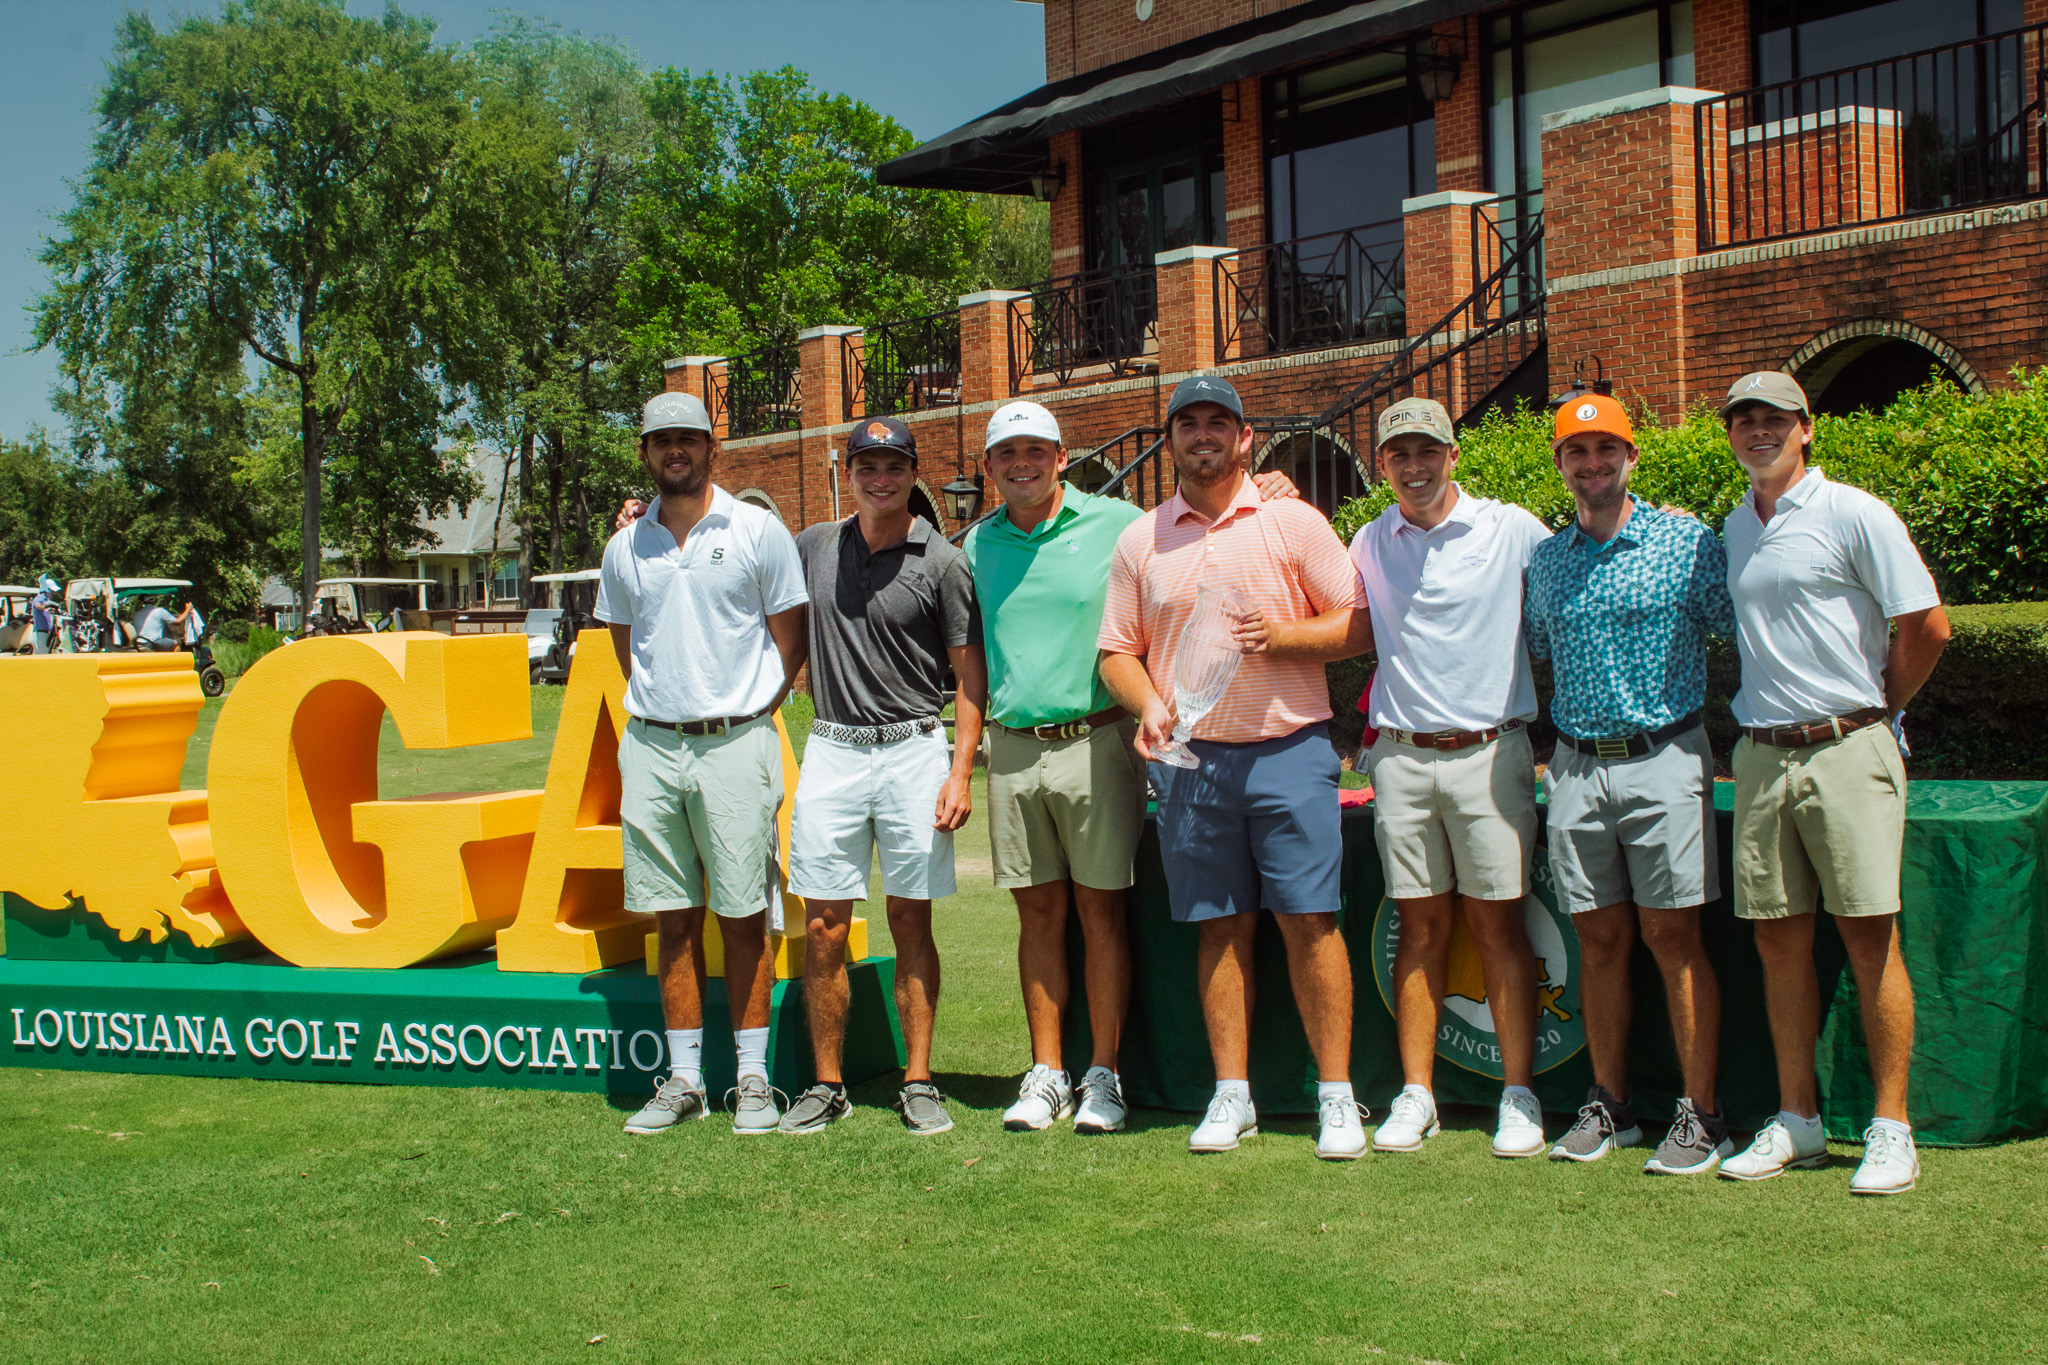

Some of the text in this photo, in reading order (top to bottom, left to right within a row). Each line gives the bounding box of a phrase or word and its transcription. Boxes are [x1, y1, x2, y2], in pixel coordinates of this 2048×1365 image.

[653, 400, 693, 416] Callaway
[1390, 411, 1432, 426] PING
[711, 548, 725, 560] S
[1501, 718, 1520, 732] LSU
[11, 1008, 672, 1071] LOUISIANA GOLF ASSOCIATIO
[1438, 1024, 1503, 1063] SINCE
